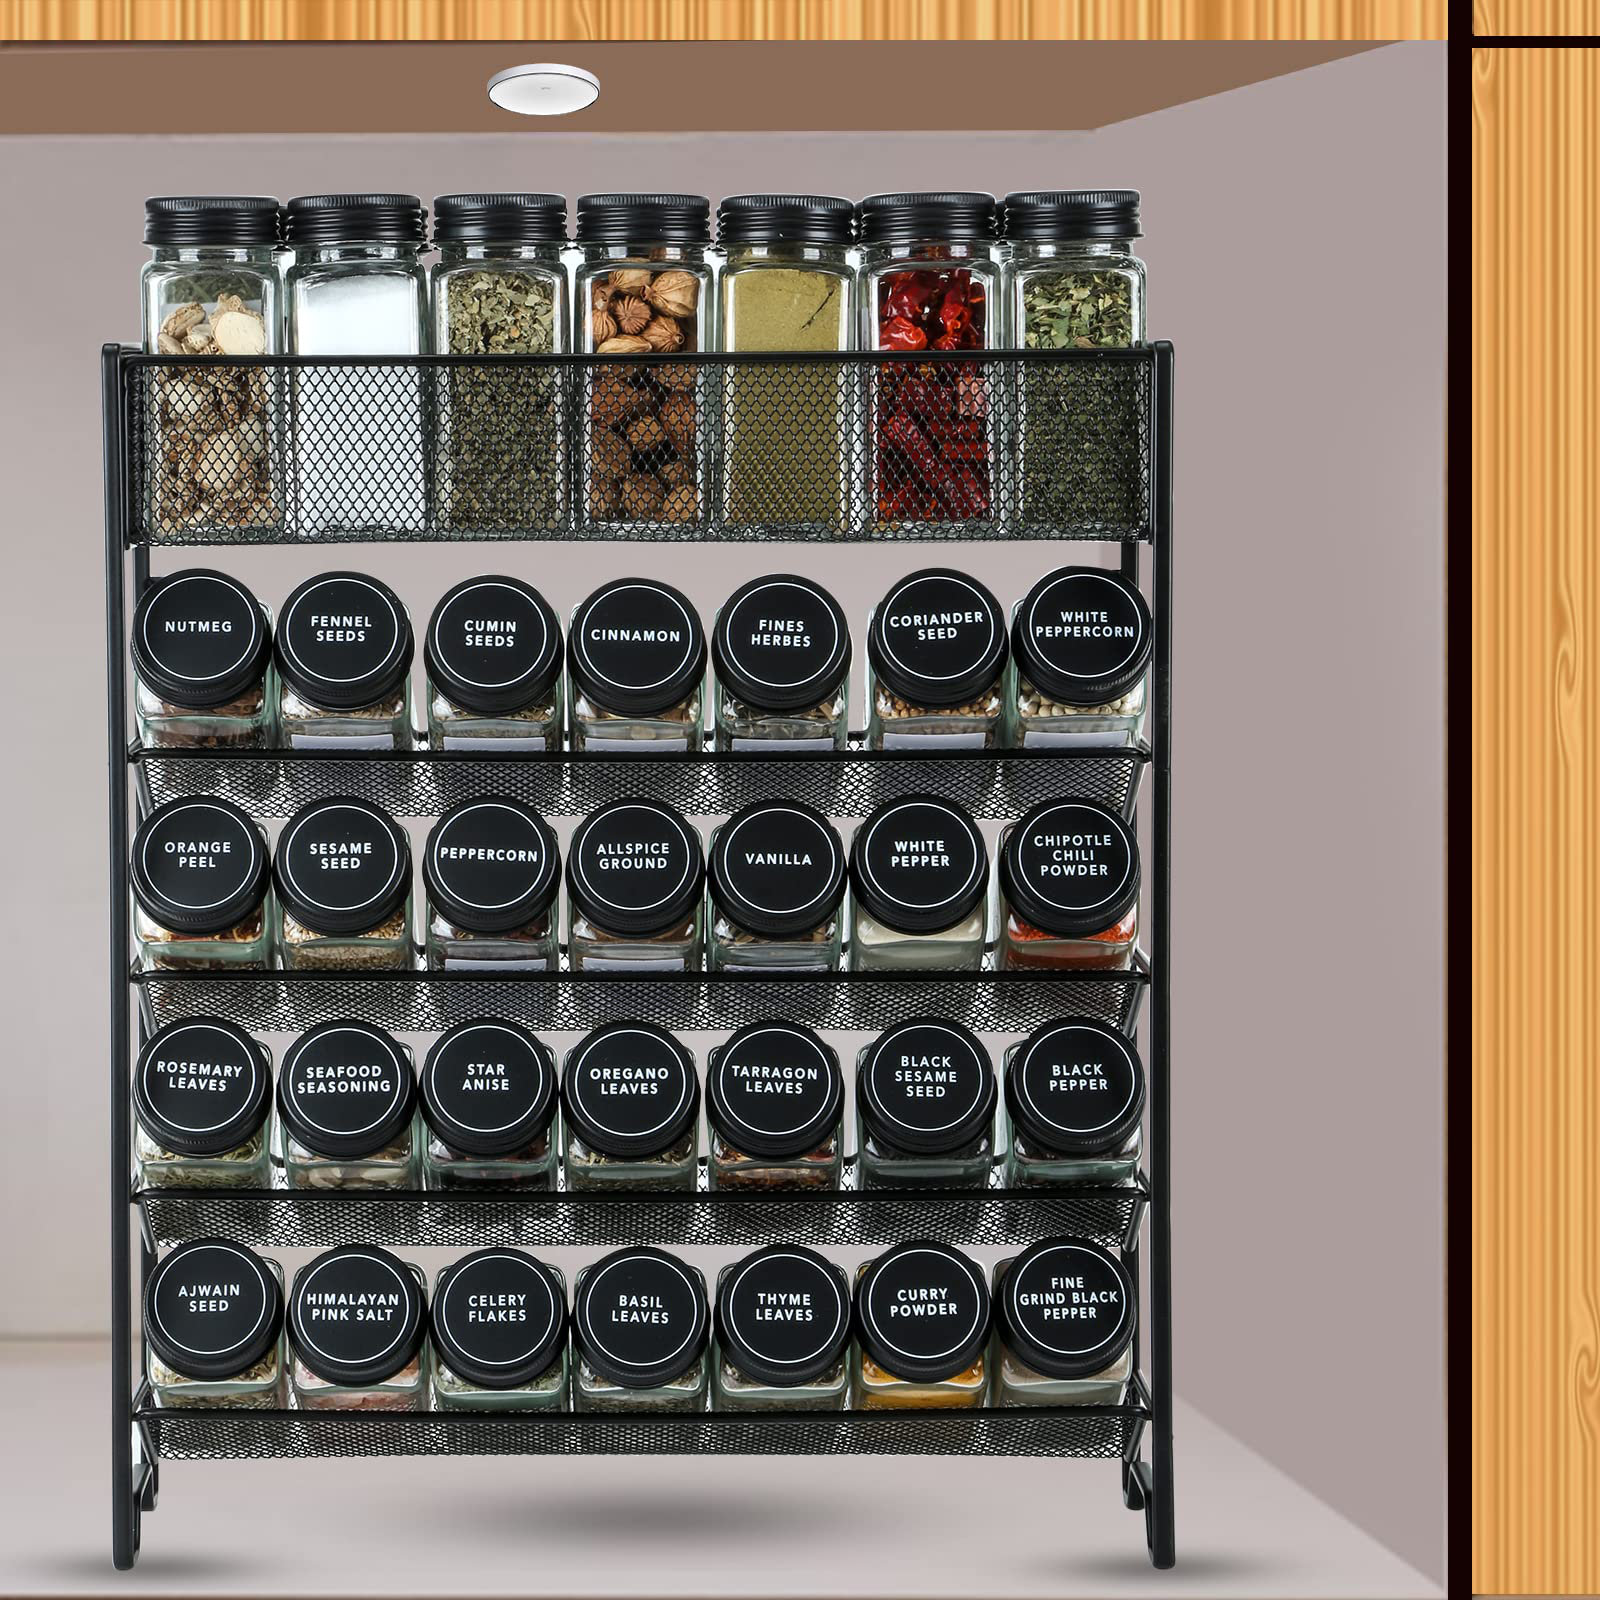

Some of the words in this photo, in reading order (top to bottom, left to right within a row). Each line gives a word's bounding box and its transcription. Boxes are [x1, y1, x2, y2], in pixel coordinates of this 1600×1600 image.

[310, 615, 372, 628] FENNEL
[889, 611, 984, 628] CORIANDER
[1060, 611, 1108, 623] WHITE
[165, 620, 232, 633] NUTMEG
[464, 619, 517, 633] CUMIN
[758, 619, 804, 633] FINES
[1035, 625, 1134, 638] PEPPERCORN
[316, 629, 366, 642] SEEDS
[465, 634, 514, 648] SEEDS
[590, 628, 680, 642] CINNAMON
[751, 633, 811, 648] HERBES
[917, 627, 958, 641] SEED
[164, 841, 231, 854] ORANGE
[894, 840, 945, 853] WHITE
[1033, 834, 1112, 847] CHIPOTLE
[309, 842, 372, 855] SESAME
[440, 846, 538, 863] PEPPERCORN
[596, 842, 670, 855] ALLSPICE
[1052, 849, 1094, 862] CHILI
[178, 856, 217, 868] PEEL
[320, 857, 361, 870] SEED
[599, 857, 668, 870] GROUND
[745, 852, 812, 866] VANILLA
[891, 854, 950, 868] PEPPER
[1040, 864, 1108, 877] POWDER
[901, 1055, 952, 1068] BLACK
[156, 1060, 243, 1078] ROSEMARY
[306, 1065, 382, 1079] SEAFOOD
[467, 1063, 505, 1076] STAR
[589, 1067, 669, 1080] OREGANO
[731, 1065, 818, 1080] TARRAGON
[1052, 1063, 1104, 1077] BLACK
[894, 1070, 957, 1083] SESAME
[168, 1076, 227, 1092] LEAVES
[297, 1079, 391, 1095] SEASONING
[462, 1078, 510, 1091] ANISE
[600, 1082, 658, 1095] LEAVES
[745, 1080, 803, 1095] LEAVES
[1049, 1078, 1108, 1092] PEPPER
[906, 1085, 946, 1098] SEED
[1051, 1276, 1084, 1290] FINE
[178, 1283, 240, 1298] AJWAIN
[897, 1287, 948, 1302] CURRY
[306, 1293, 399, 1306] HIMALAYAN
[468, 1294, 527, 1307] CELERY
[619, 1294, 663, 1309] BASIL
[757, 1292, 811, 1306] THYME
[1019, 1292, 1066, 1306] GRIND
[1071, 1290, 1119, 1304] BLACK
[189, 1299, 229, 1313] SEED
[890, 1302, 958, 1318] POWDER
[311, 1308, 349, 1321] PINK
[356, 1308, 394, 1321] SALT
[468, 1309, 527, 1323] FLAKES
[611, 1309, 669, 1324] LEAVES
[755, 1308, 813, 1322] LEAVES
[1043, 1306, 1097, 1321] PEPPER
